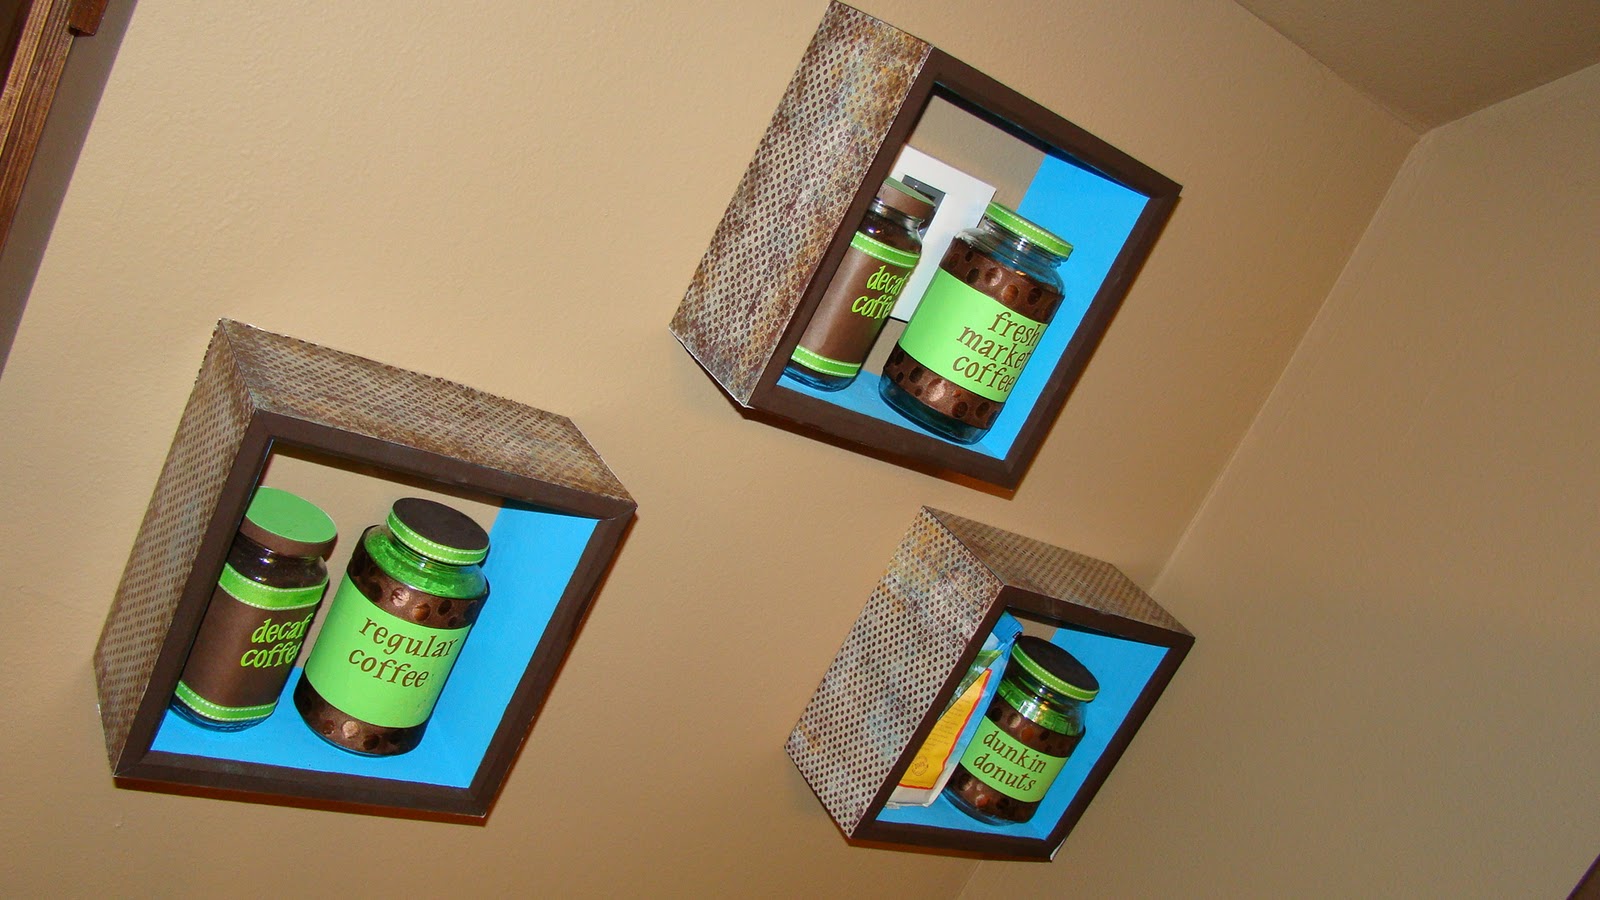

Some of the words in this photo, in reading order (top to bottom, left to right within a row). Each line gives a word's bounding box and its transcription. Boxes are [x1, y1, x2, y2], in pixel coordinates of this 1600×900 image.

[851, 294, 895, 320] coffe
[987, 311, 1041, 347] fresh
[952, 356, 1016, 392] coffee
[251, 612, 314, 643] decaf
[358, 617, 459, 658] regular
[240, 641, 303, 668] coffe
[348, 649, 430, 688] coffee
[982, 730, 1047, 774] dunkin
[973, 752, 1037, 792] donuts
